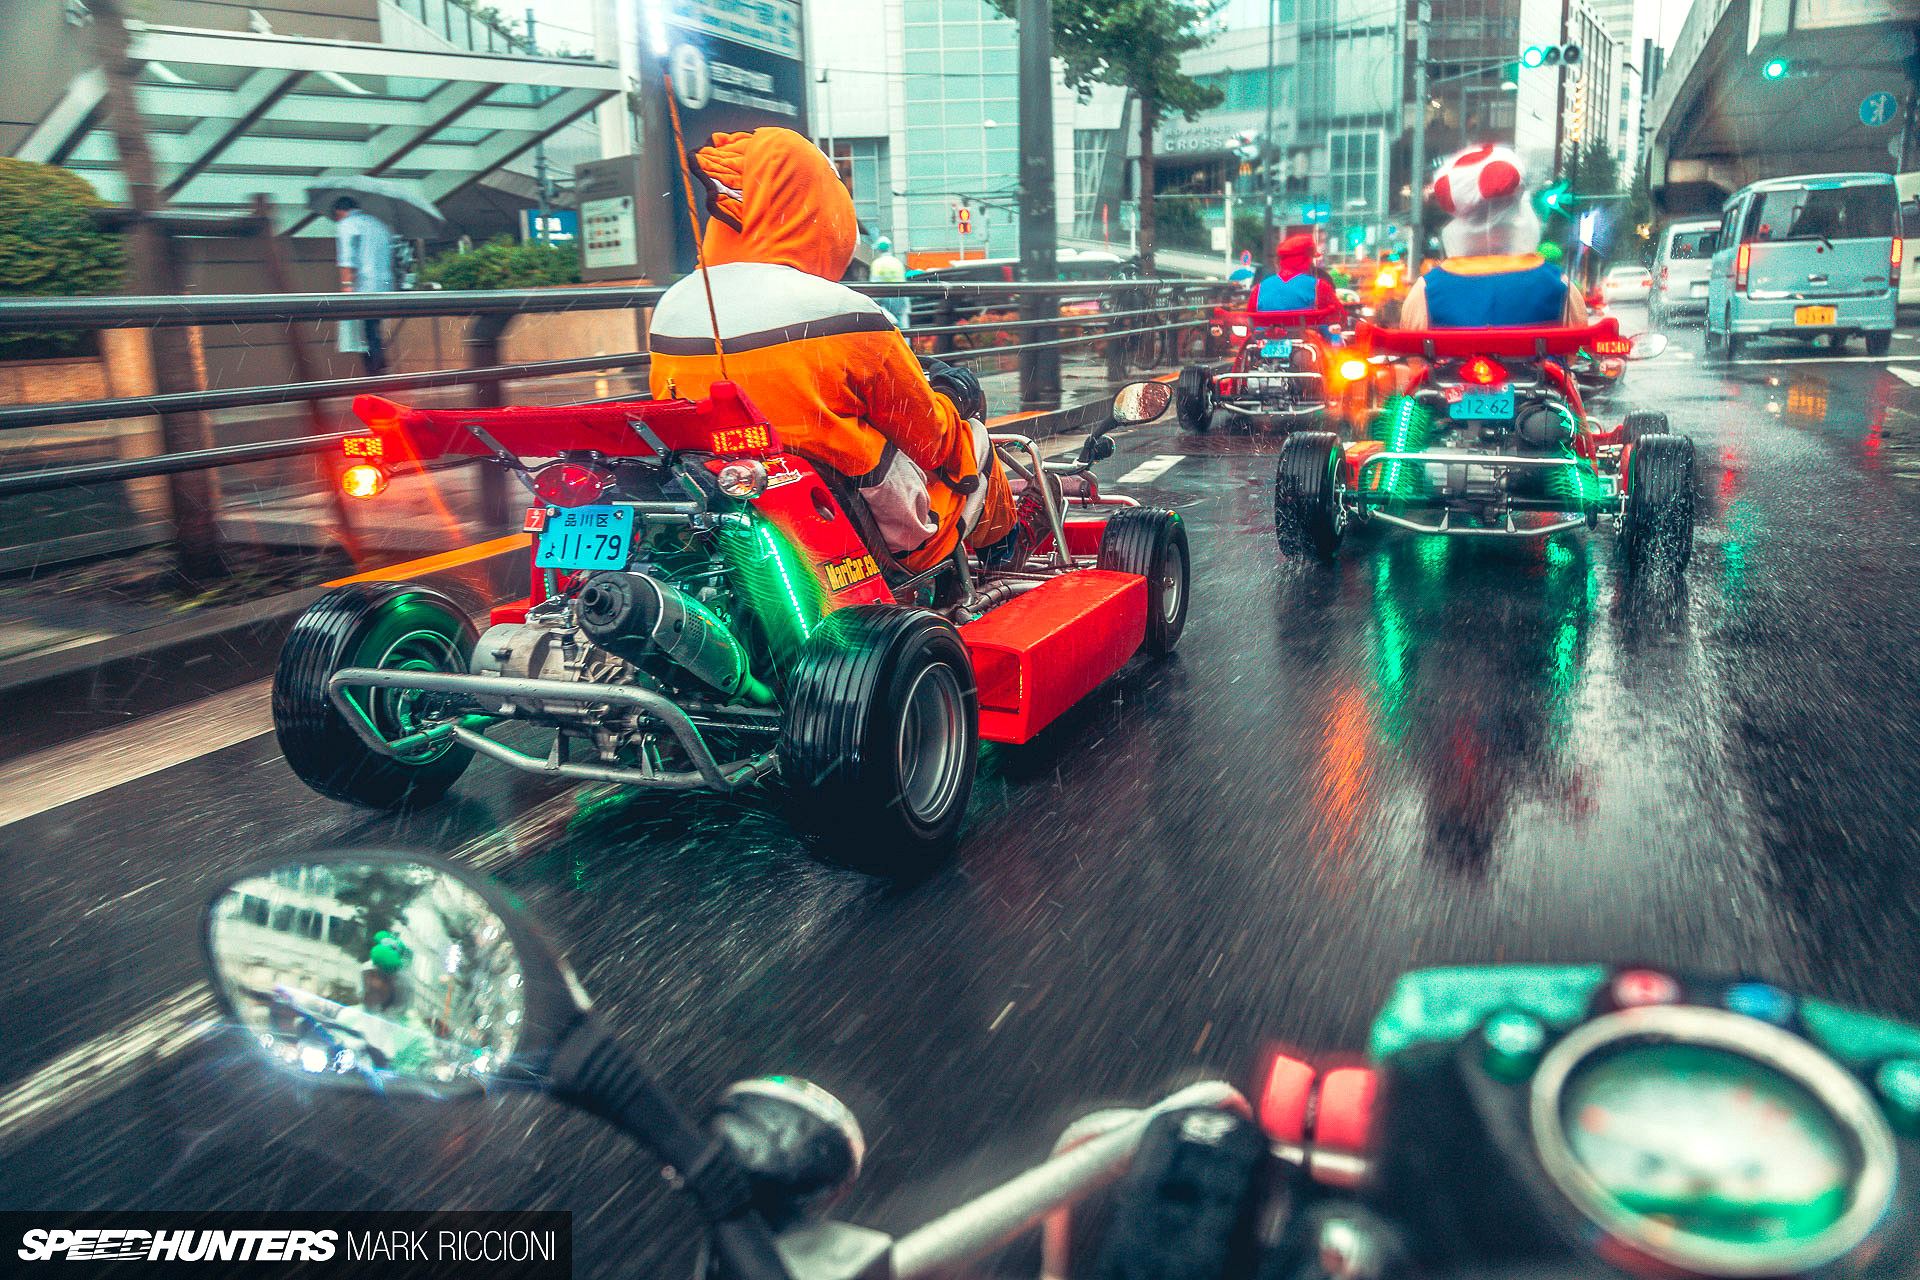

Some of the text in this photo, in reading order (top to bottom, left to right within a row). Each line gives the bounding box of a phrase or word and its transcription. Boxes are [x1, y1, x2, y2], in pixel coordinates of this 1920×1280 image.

[1165, 138, 1223, 151] CROSS
[564, 513, 609, 527] 品川区
[561, 533, 622, 561] 11-79
